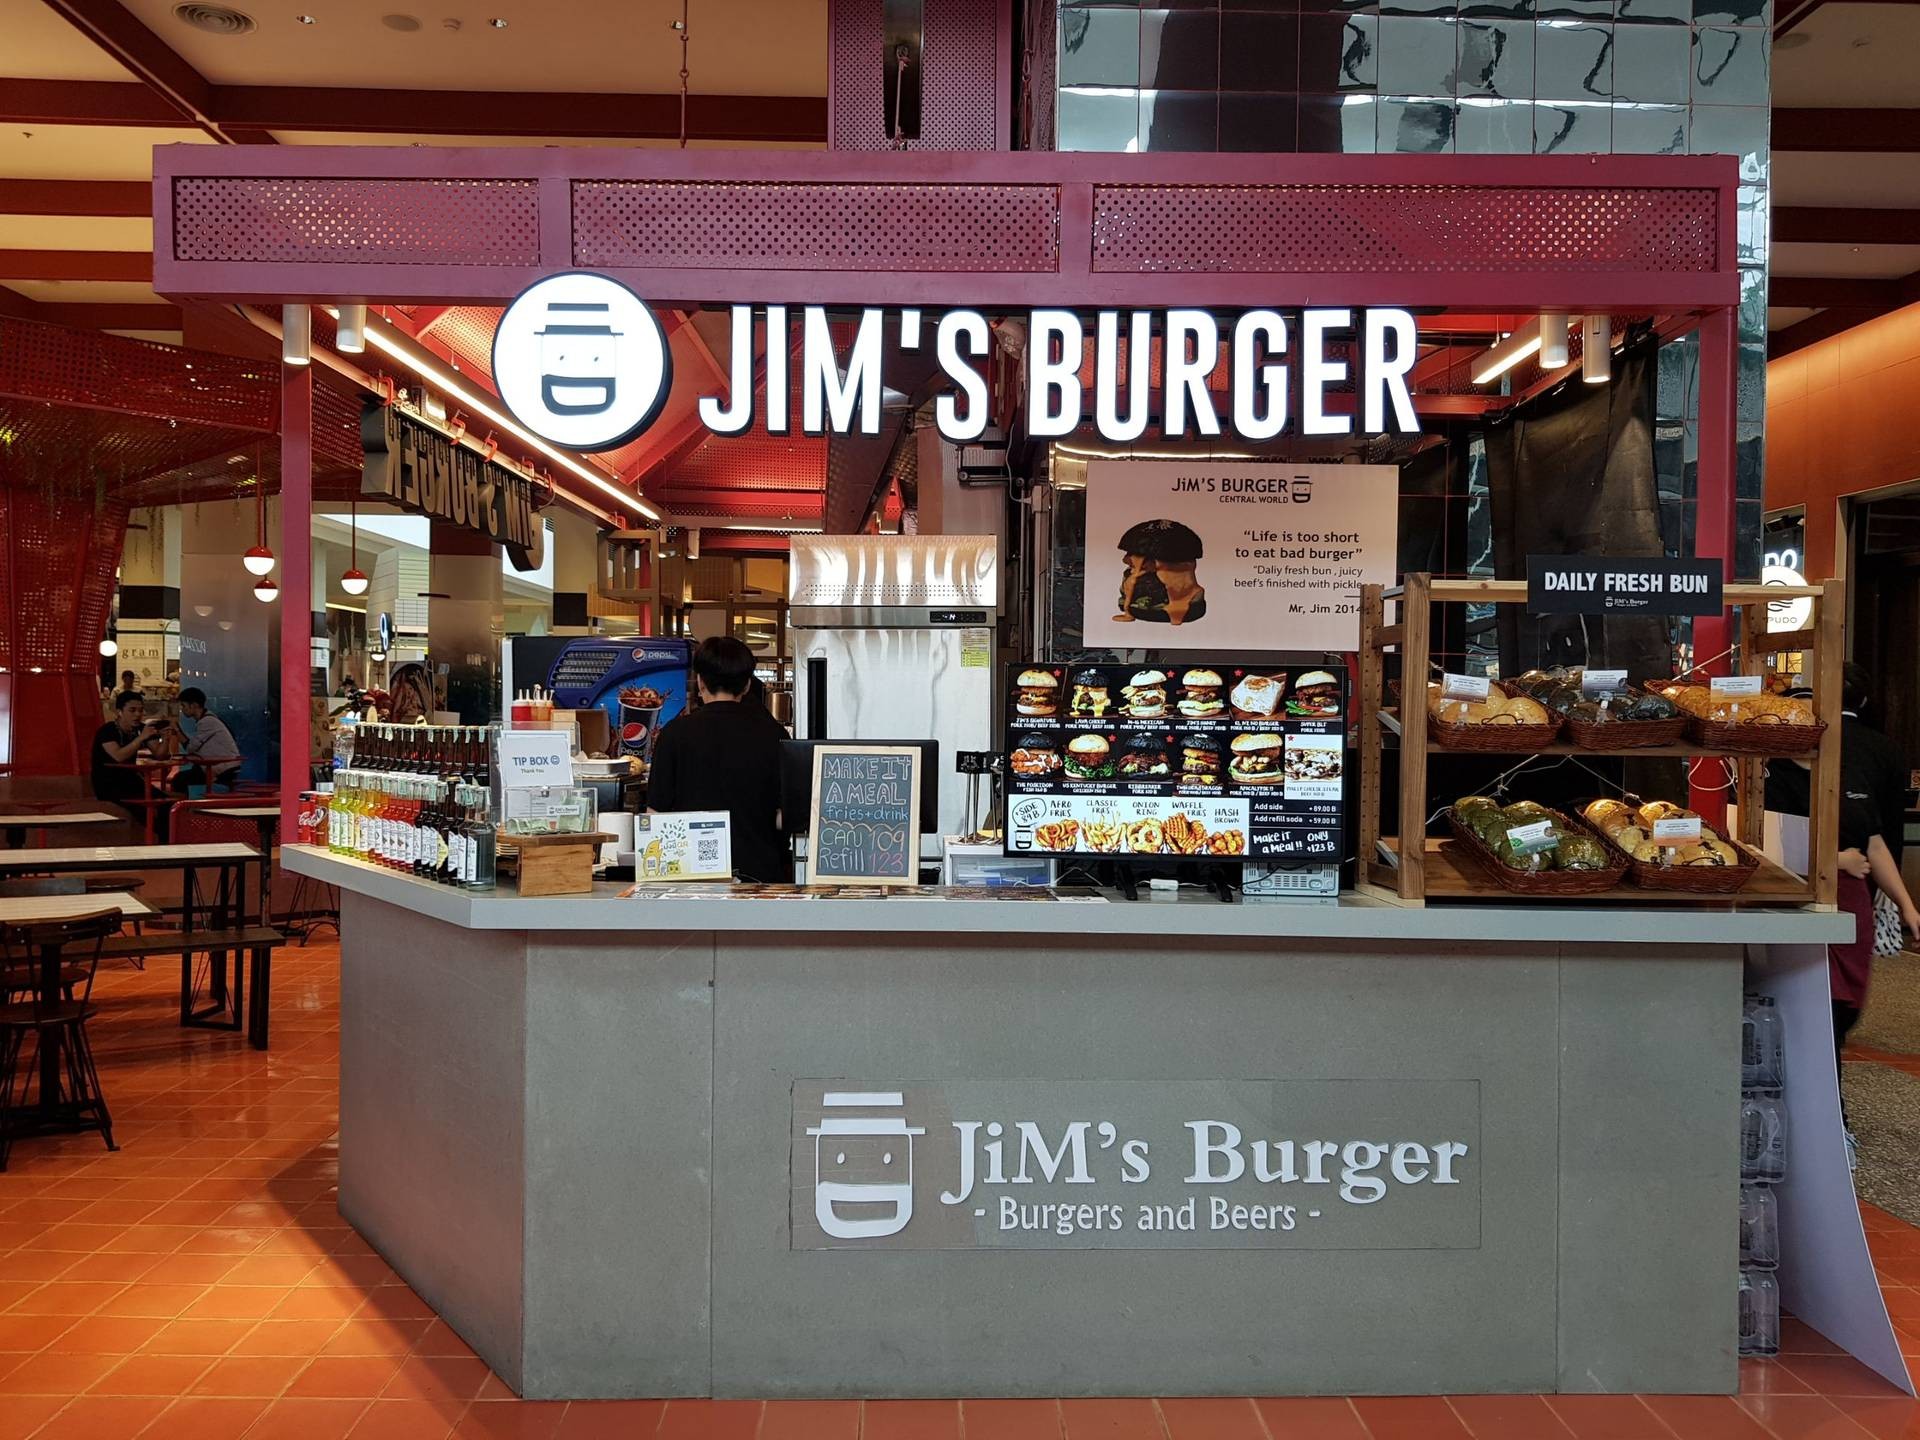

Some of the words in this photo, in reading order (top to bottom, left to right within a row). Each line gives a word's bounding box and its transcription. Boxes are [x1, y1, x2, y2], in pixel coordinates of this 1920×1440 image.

[698, 304, 992, 441] JIM'S
[1028, 308, 1421, 441] BURGER
[1221, 479, 1288, 493] BURGER
[1219, 496, 1256, 504] CENTRAL
[1258, 496, 1289, 504] WORLD
[1281, 531, 1293, 542] is
[1297, 532, 1320, 543] too
[1323, 531, 1359, 543] short
[1235, 548, 1250, 558] to
[1253, 548, 1276, 559] eat
[1279, 547, 1305, 559] bad
[1284, 565, 1309, 576] fresh
[1338, 566, 1363, 578] juicy
[1266, 578, 1306, 589] finished
[1308, 579, 1331, 589] with
[1544, 572, 1598, 592] DAILY
[1603, 573, 1664, 593] FRESH
[1669, 574, 1708, 594] BUN
[1310, 604, 1331, 614] Jim
[122, 648, 159, 658] gram
[648, 650, 671, 660] pepsi
[512, 756, 527, 766] TIP
[529, 756, 550, 766] BOX
[823, 757, 880, 780] MAKE
[825, 781, 844, 805] A
[846, 782, 907, 806] MEAL
[1050, 800, 1073, 809] AFRO
[1171, 801, 1204, 809] WAFFLE
[1050, 808, 1072, 818] FRIES
[1136, 808, 1158, 816] RING
[1186, 808, 1207, 817] FRIES
[1214, 808, 1239, 817] HASH
[1214, 816, 1240, 824] BROWN
[1286, 815, 1303, 823] soda
[869, 829, 905, 852] 109
[818, 847, 865, 873] Refill
[868, 851, 904, 874] 123
[940, 1120, 1152, 1206] JiM's
[1183, 1119, 1468, 1206] Burger
[999, 1197, 1123, 1236] Burgers
[1137, 1197, 1196, 1232] and
[1208, 1196, 1297, 1232] Beers
